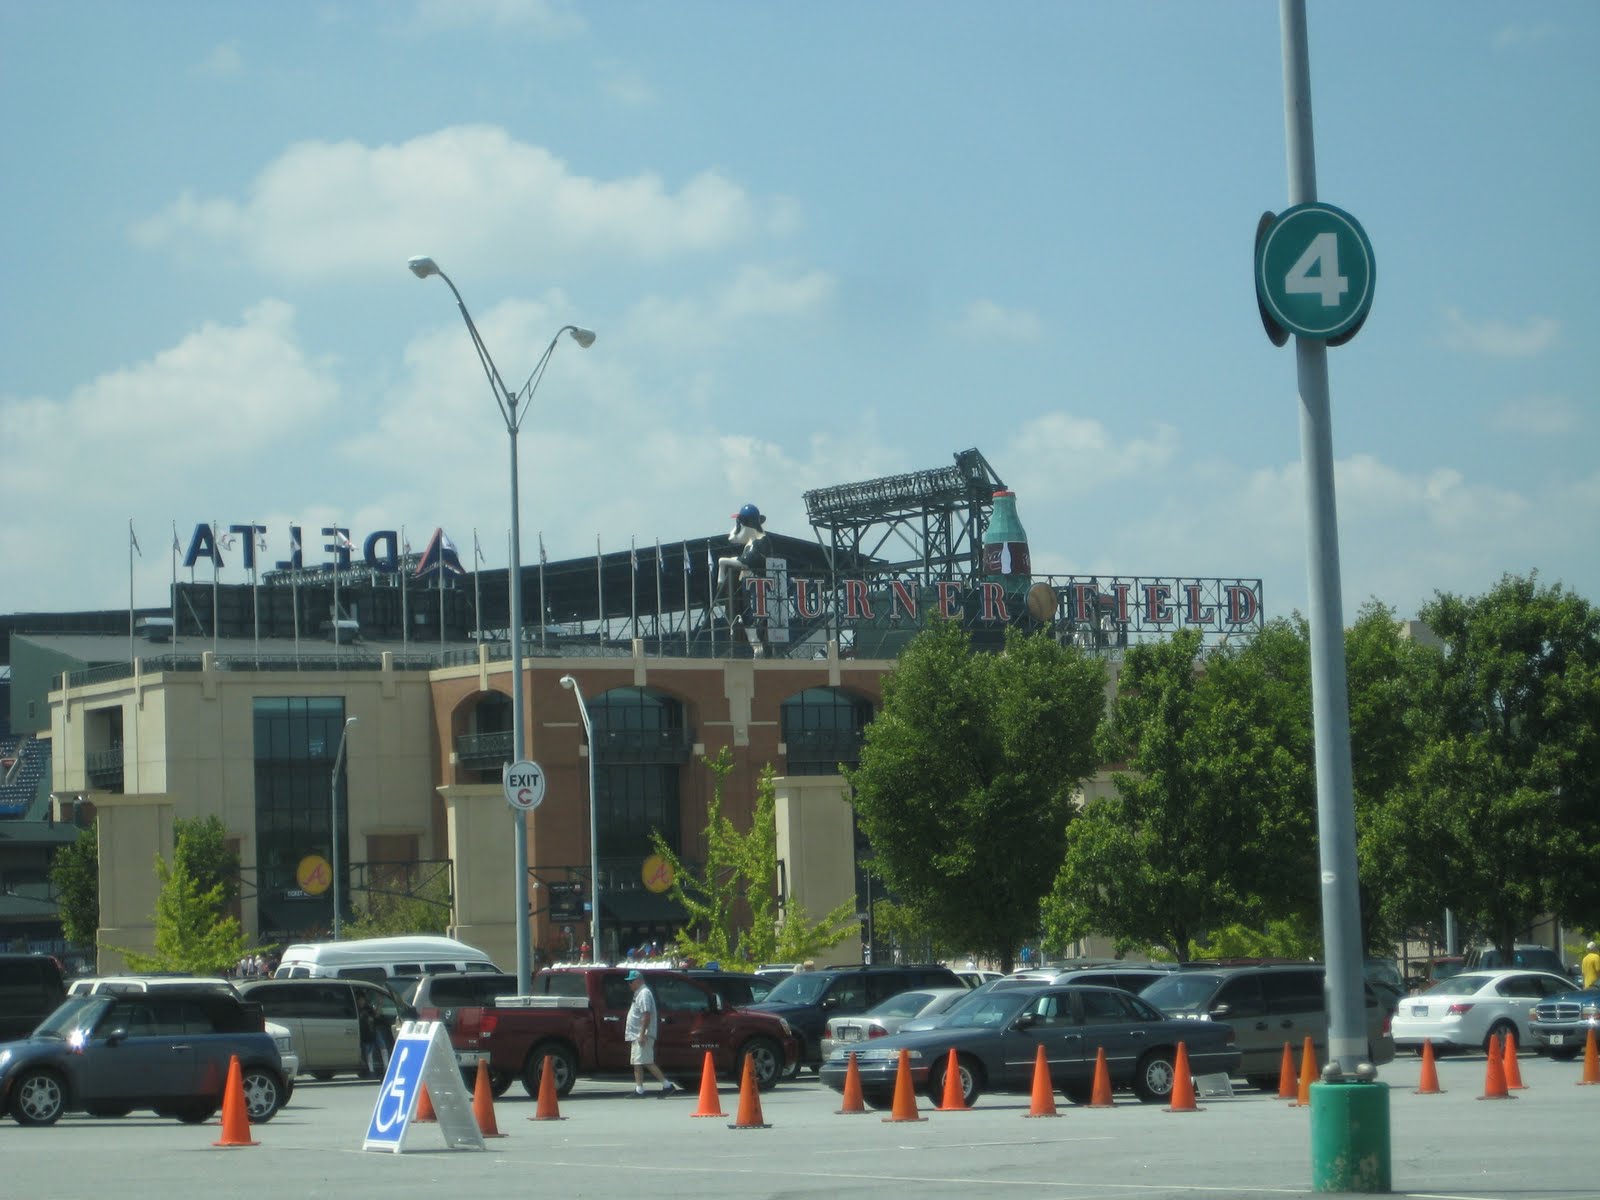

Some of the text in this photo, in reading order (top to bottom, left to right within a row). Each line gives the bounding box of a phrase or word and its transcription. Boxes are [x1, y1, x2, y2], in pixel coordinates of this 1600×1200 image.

[1285, 232, 1349, 307] 4
[745, 577, 1258, 625] TURNER FIELD
[509, 774, 539, 787] EXIT
[517, 788, 532, 805] C
